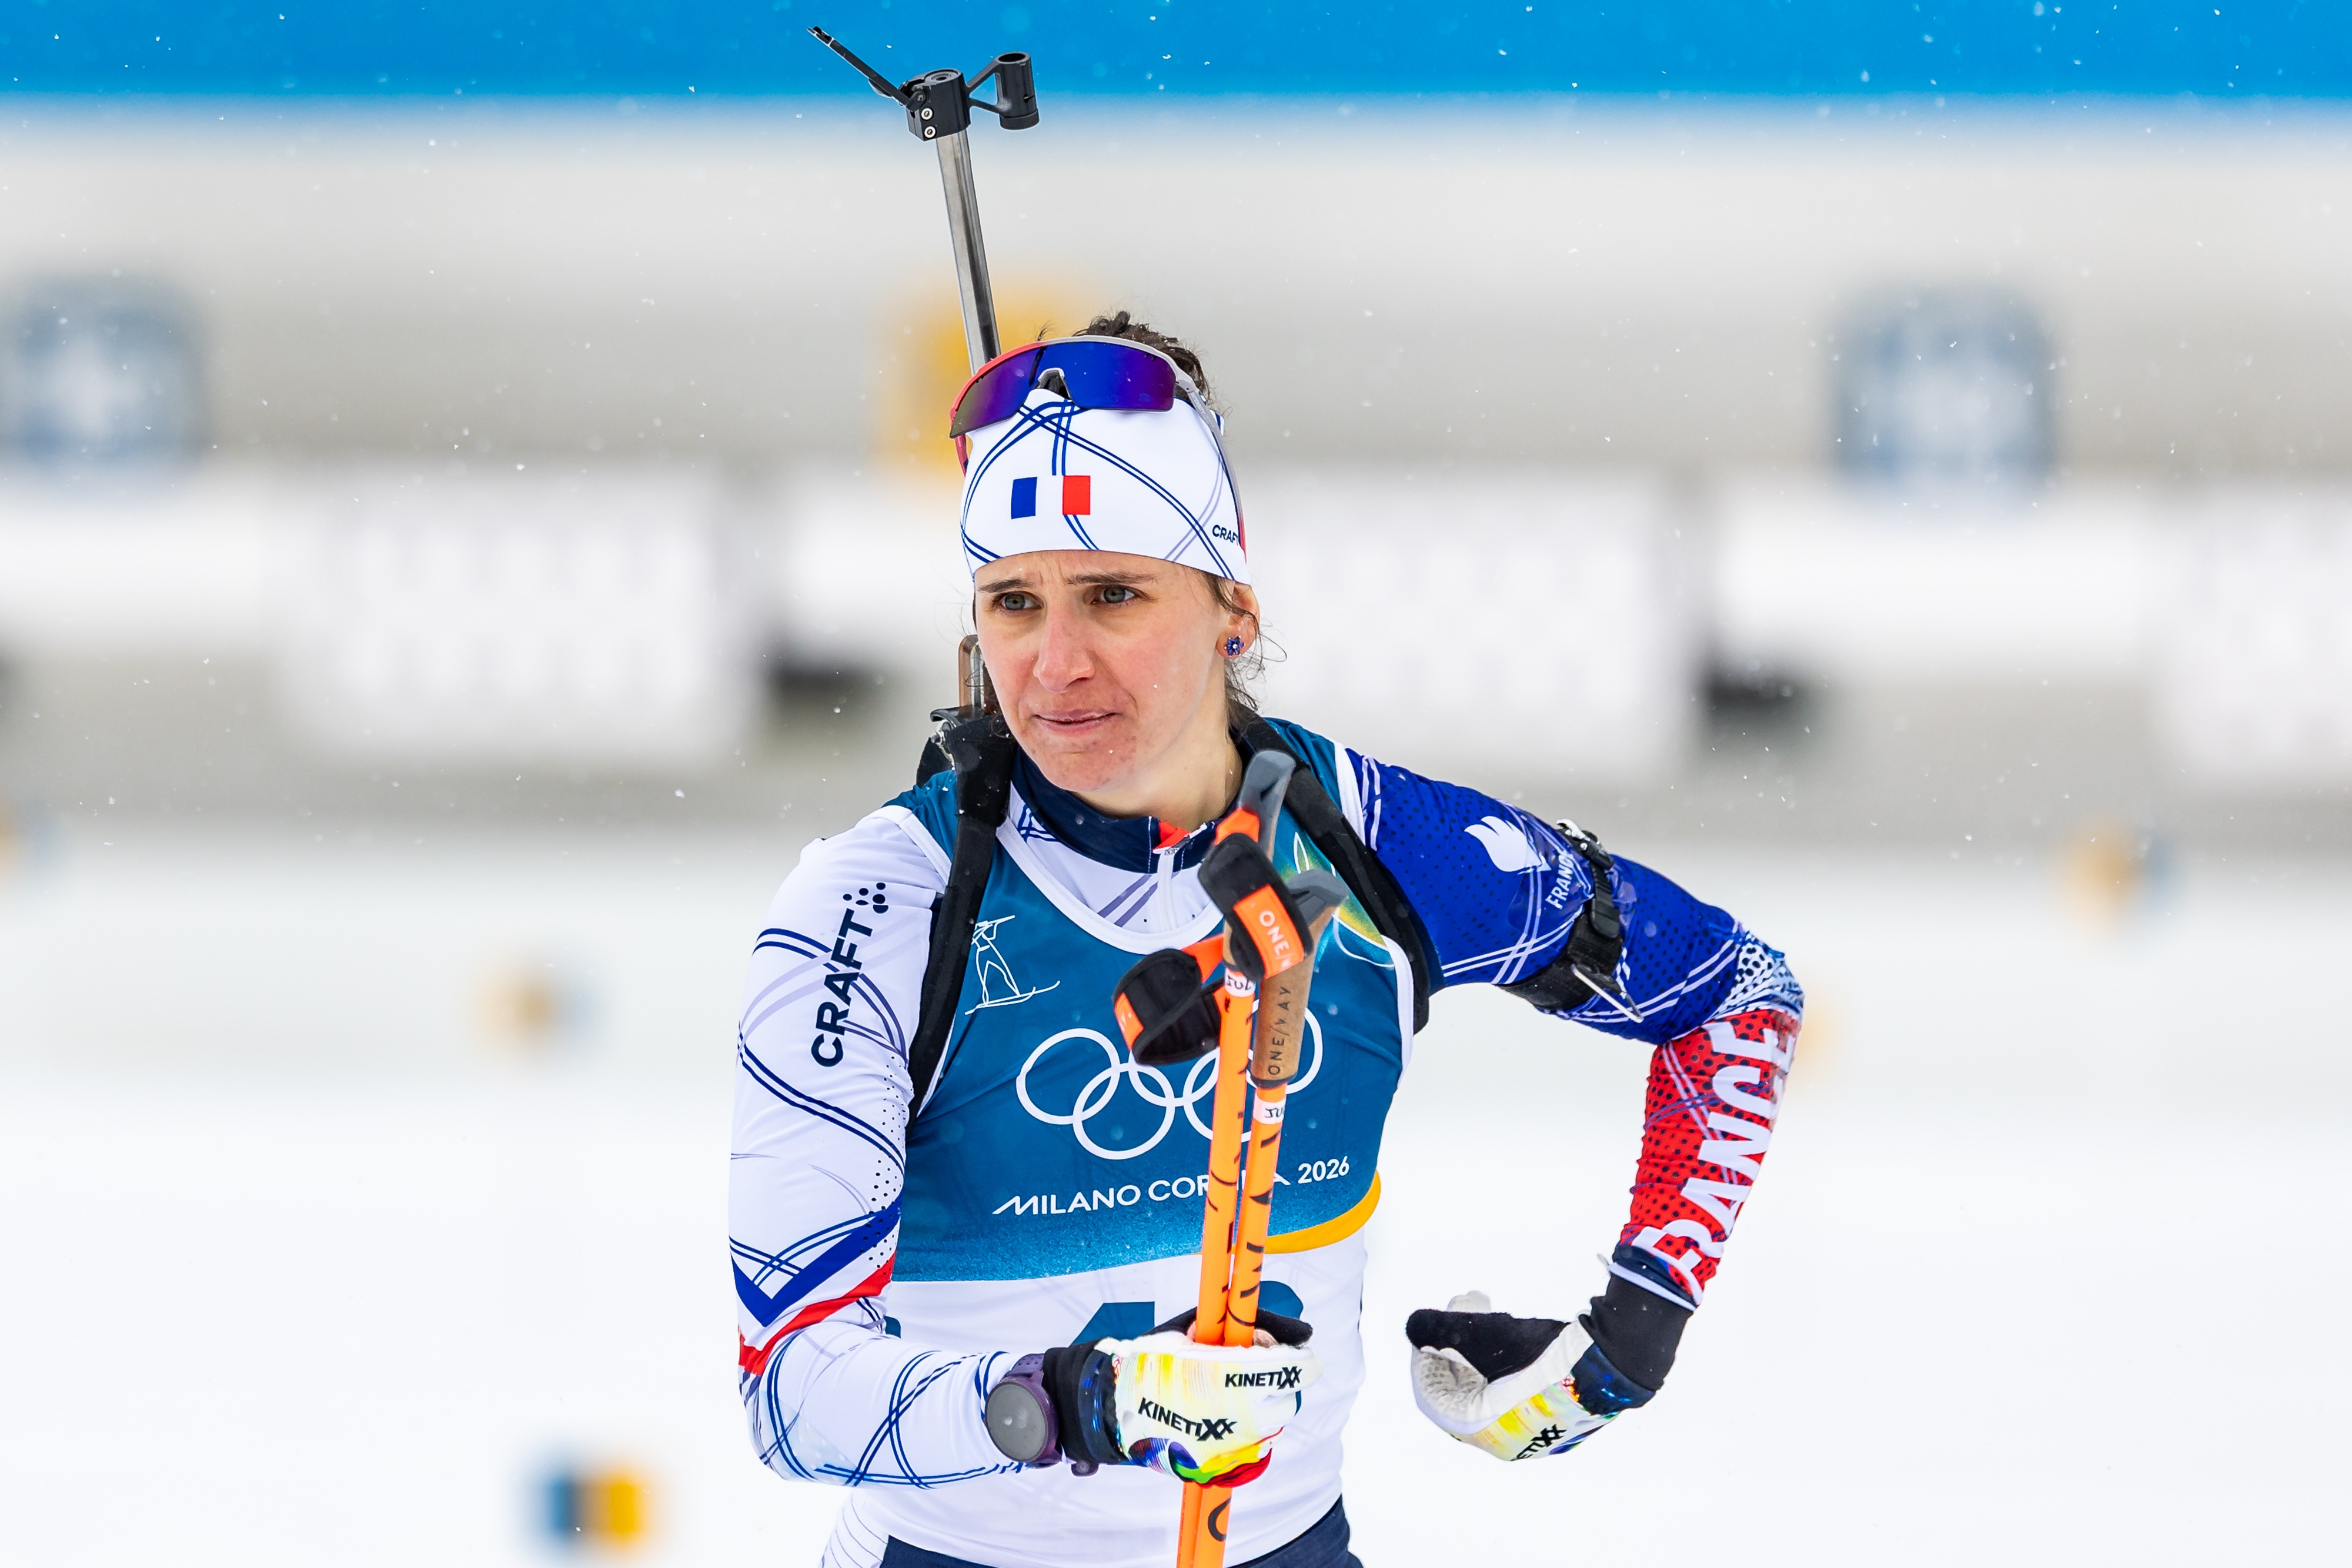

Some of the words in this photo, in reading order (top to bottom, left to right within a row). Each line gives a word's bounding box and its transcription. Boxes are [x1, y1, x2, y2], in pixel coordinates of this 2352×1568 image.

[810, 907, 873, 1067] CRAFT
[992, 1185, 1141, 1215] MILANO
[1148, 1169, 1291, 1201] CORA
[1297, 1156, 1350, 1184] 2026
[1632, 1021, 1798, 1306] FRANCE
[1510, 1423, 1568, 1462] ETIXX
